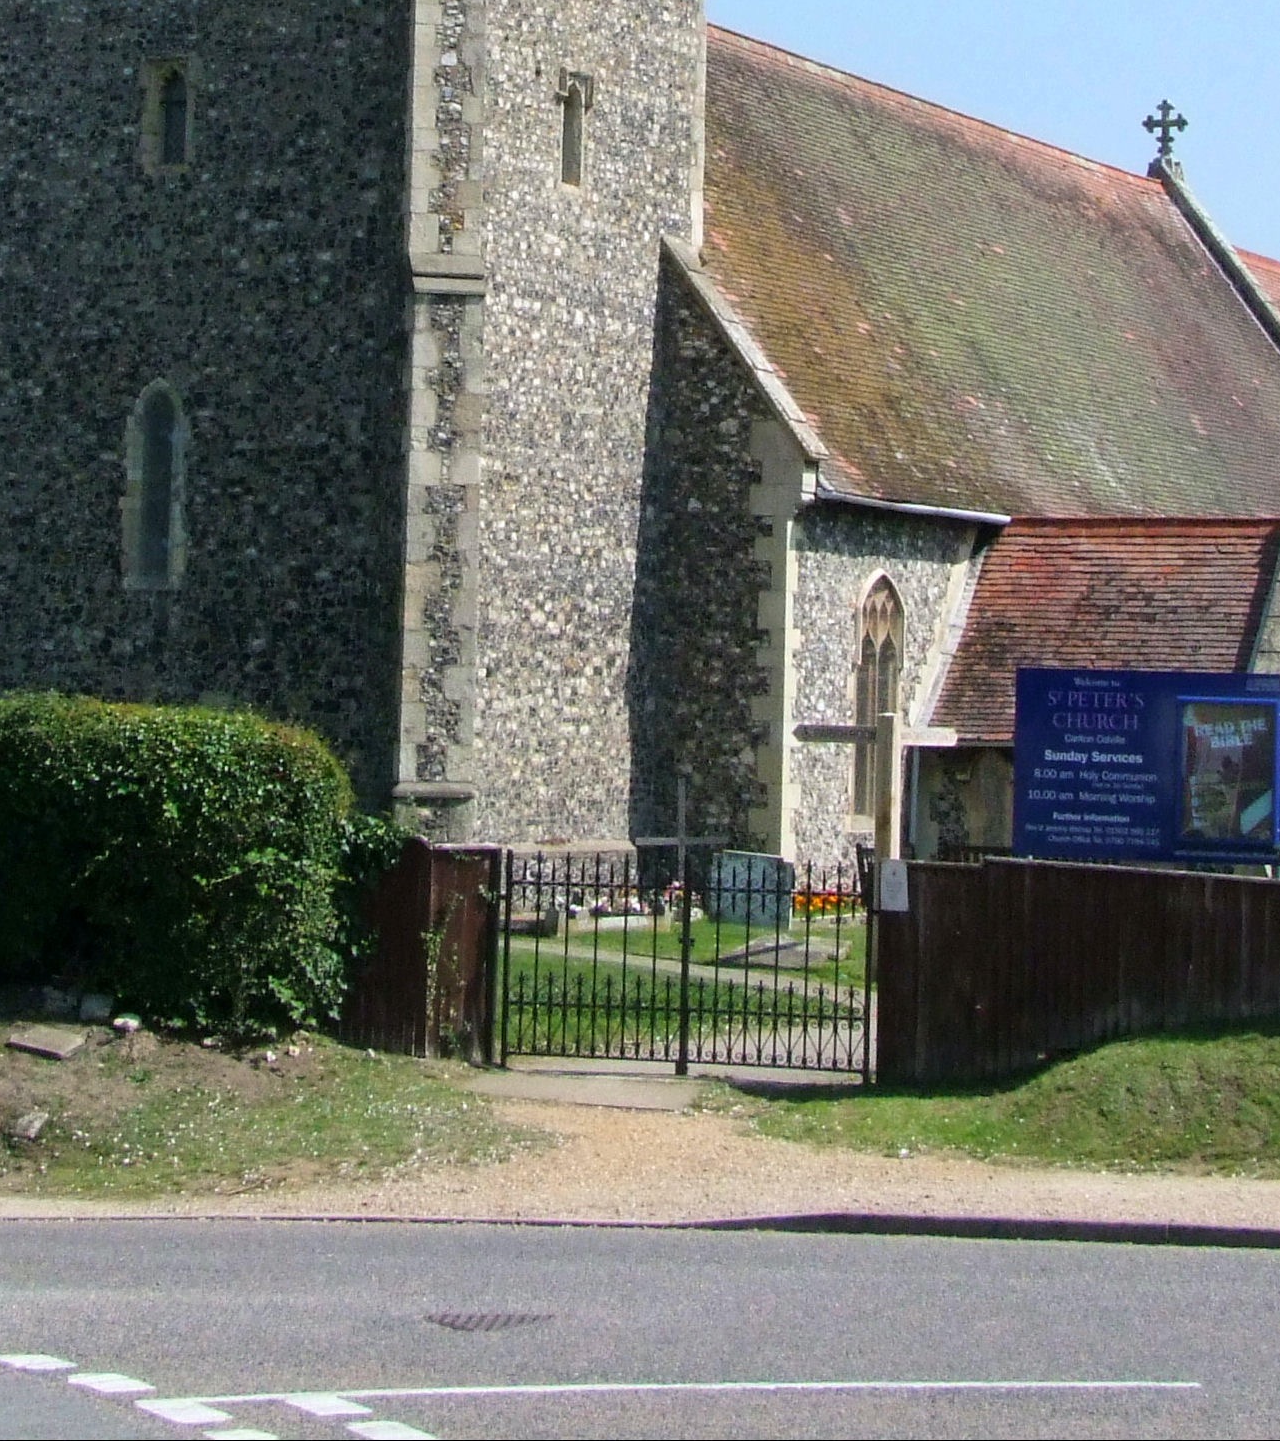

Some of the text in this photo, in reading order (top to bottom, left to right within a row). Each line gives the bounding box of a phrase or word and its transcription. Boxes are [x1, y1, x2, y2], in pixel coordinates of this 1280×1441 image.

[1068, 690, 1144, 708] PETER'S
[1052, 711, 1138, 730] CHURCH
[1044, 749, 1143, 764] Sunday Services
[1034, 767, 1157, 783] 8.00 am Holy Communion
[1028, 789, 1156, 806] 10.00 am Morning Worship
